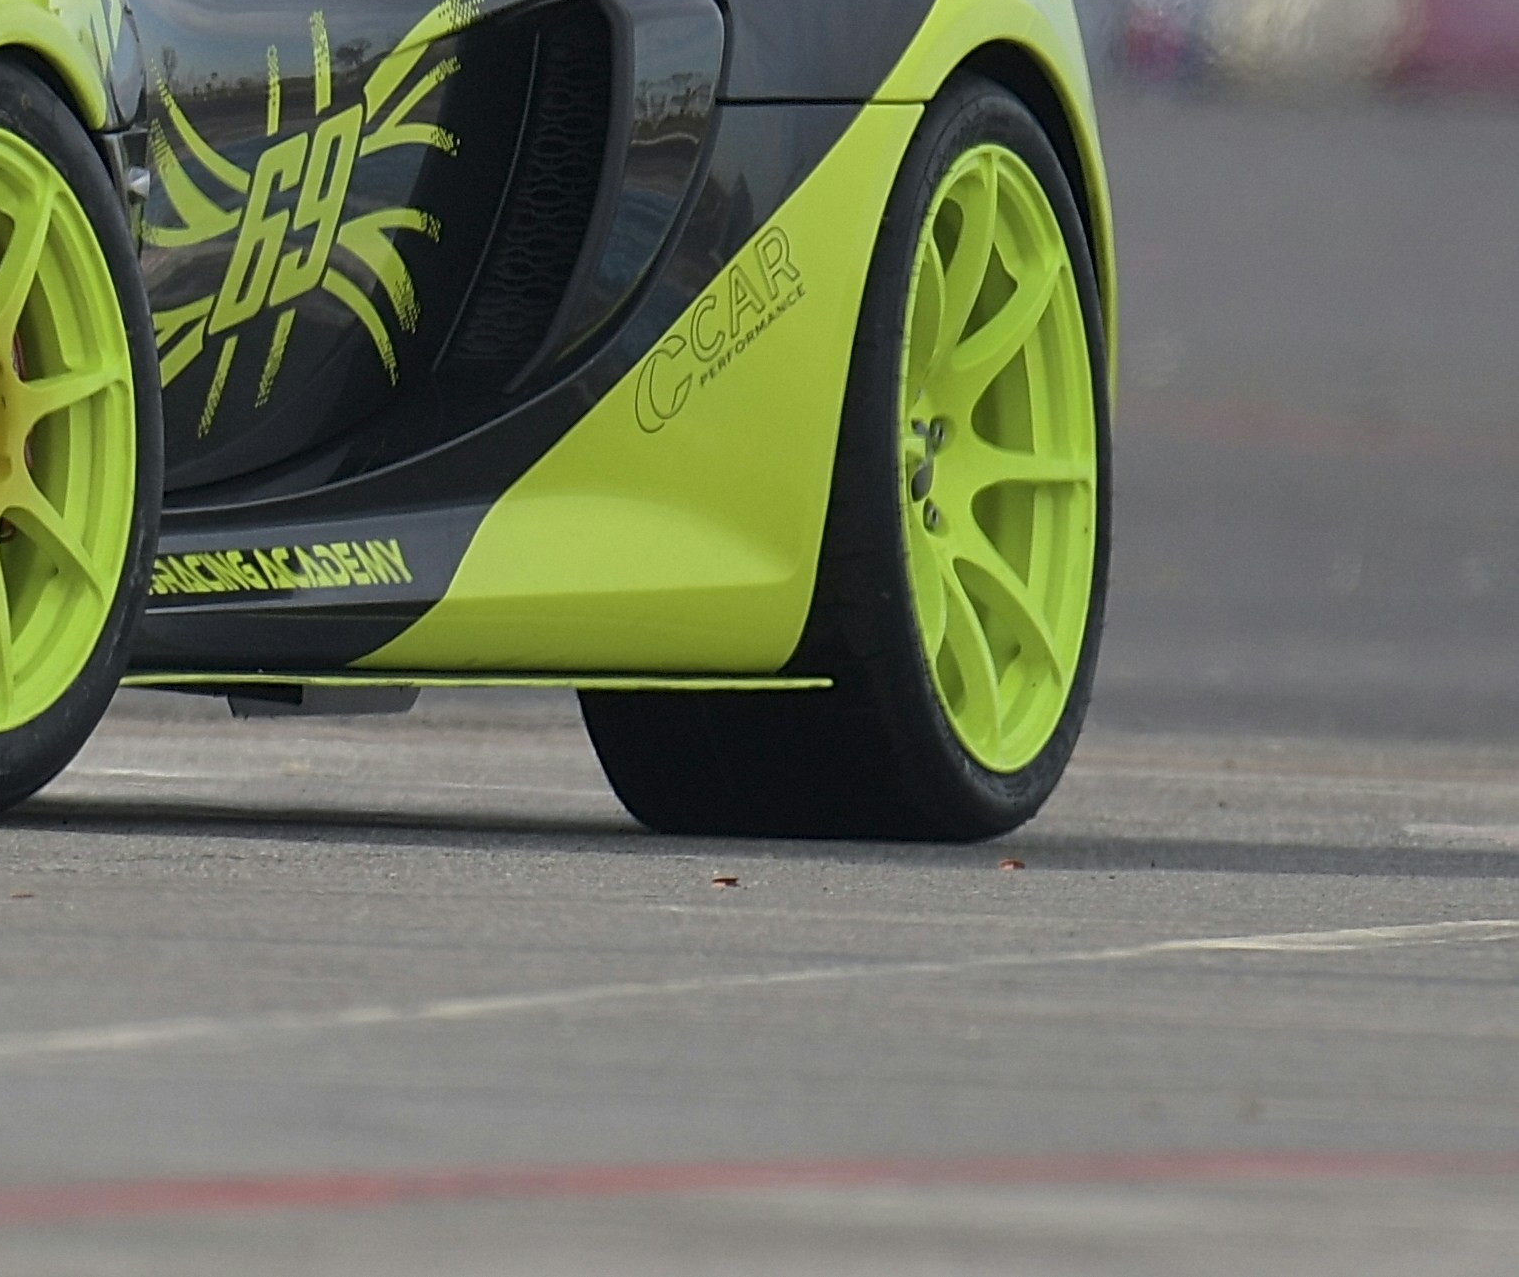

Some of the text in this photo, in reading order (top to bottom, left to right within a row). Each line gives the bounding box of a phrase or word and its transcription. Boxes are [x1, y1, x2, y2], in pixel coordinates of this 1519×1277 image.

[208, 103, 364, 336] 69
[699, 282, 806, 387] PERFORMANCE
[253, 538, 413, 590] ACADEMY
